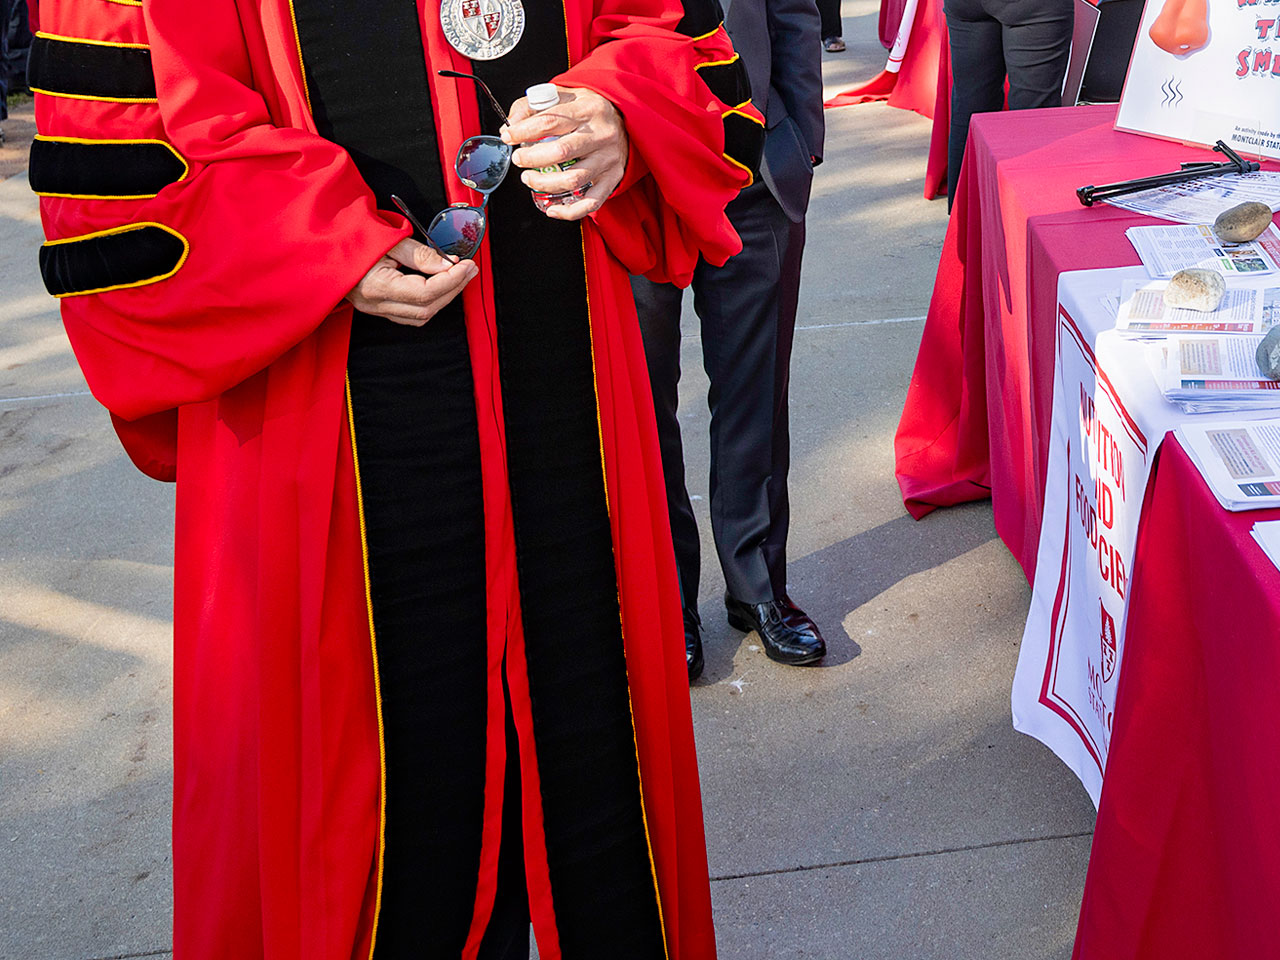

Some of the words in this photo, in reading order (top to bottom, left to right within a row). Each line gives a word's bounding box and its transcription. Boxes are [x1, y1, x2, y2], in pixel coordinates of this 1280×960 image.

[1231, 133, 1265, 147] MONTCLAIR
[1079, 380, 1126, 503] NUTITION
[1075, 472, 1098, 551] FOOD
